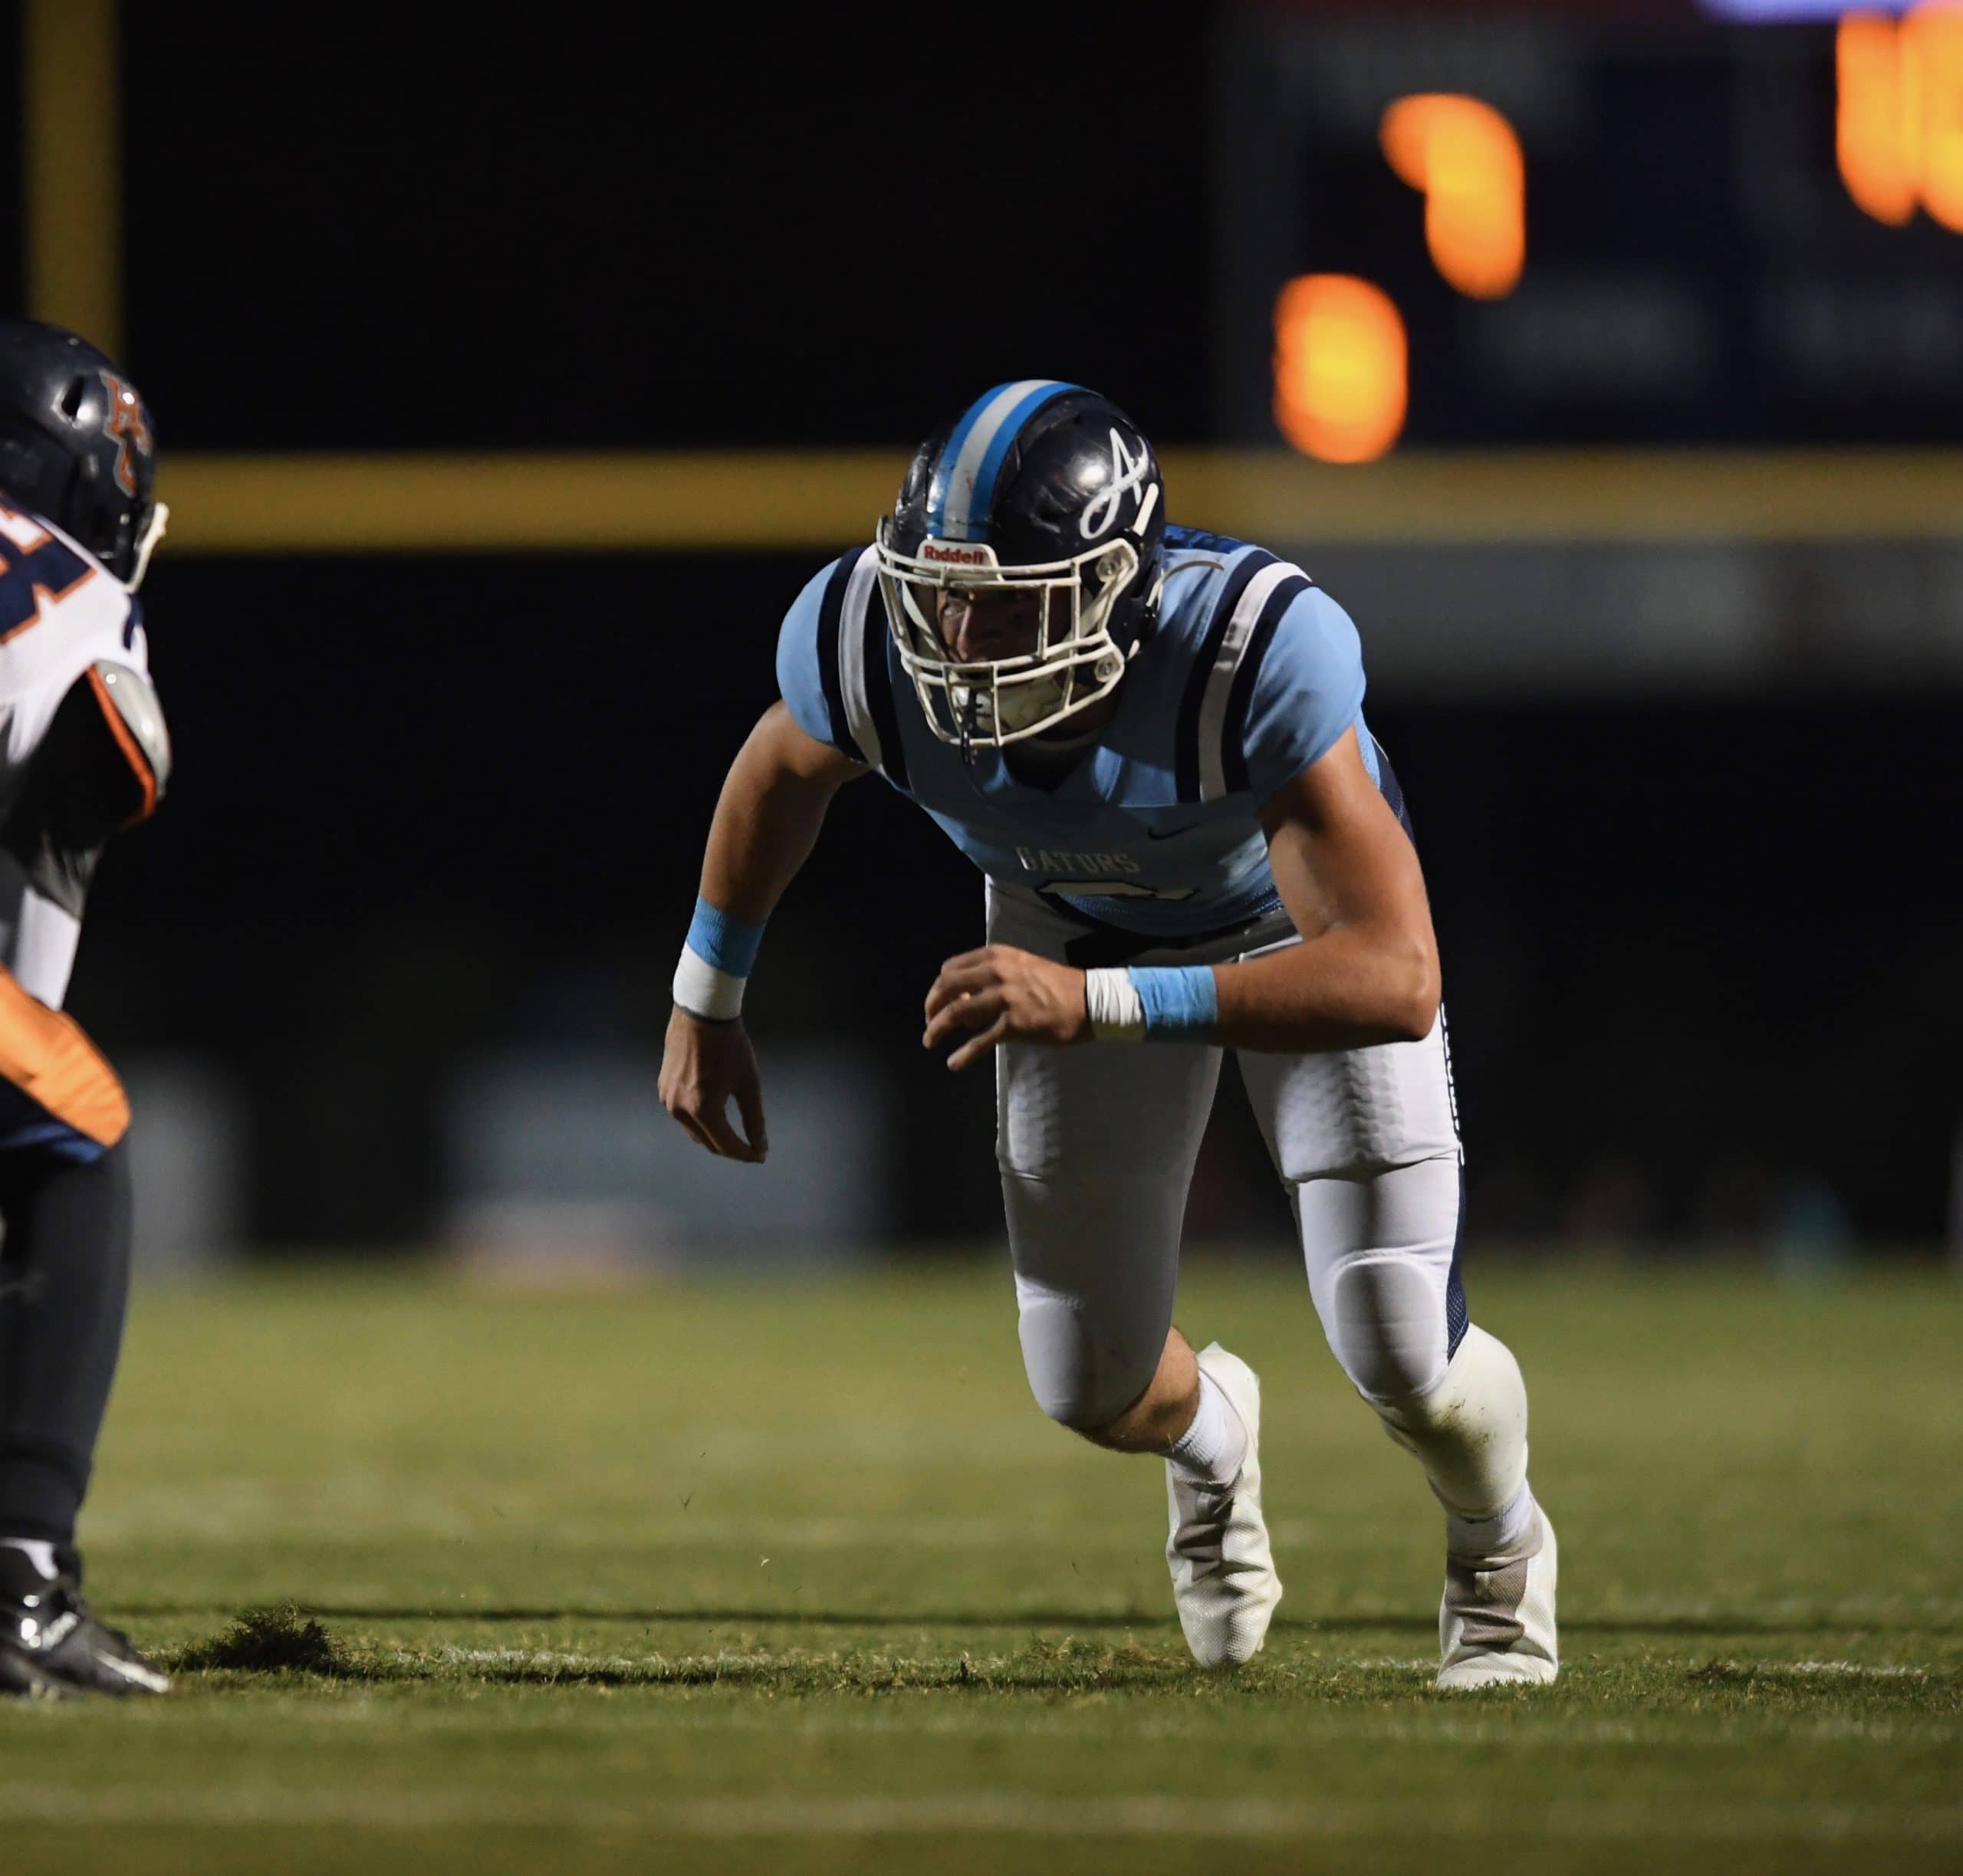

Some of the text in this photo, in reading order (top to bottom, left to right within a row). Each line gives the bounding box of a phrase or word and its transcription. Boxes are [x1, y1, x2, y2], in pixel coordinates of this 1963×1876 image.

[1080, 427, 1149, 540] A
[924, 545, 984, 565] Riddell
[1014, 846, 1141, 873] GATORS
